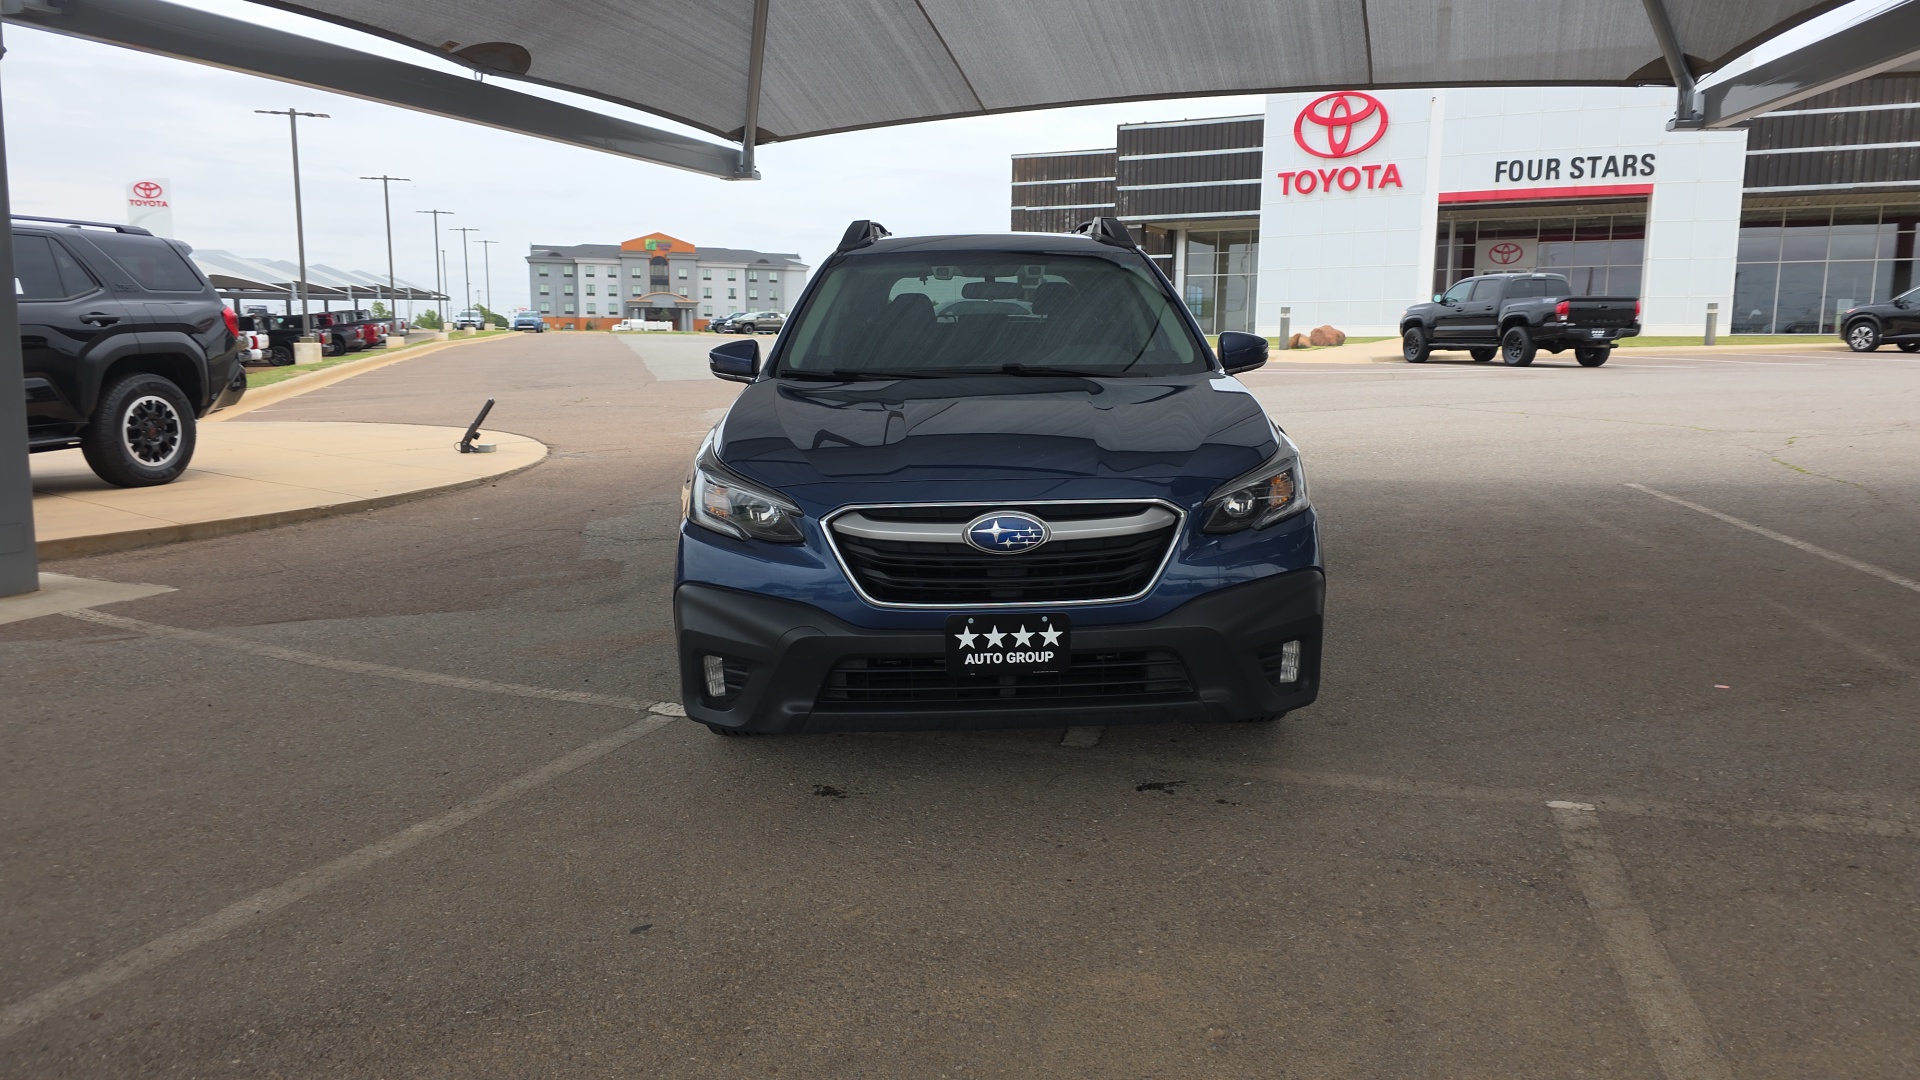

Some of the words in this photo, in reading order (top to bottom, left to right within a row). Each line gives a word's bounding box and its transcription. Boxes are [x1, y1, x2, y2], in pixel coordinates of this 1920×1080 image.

[1495, 158, 1561, 182] FOUR
[1570, 153, 1656, 179] STARS
[1278, 164, 1403, 195] TOYOTA
[128, 199, 169, 207] TOYOTA
[964, 652, 1003, 665] AUTO
[1006, 651, 1055, 663] GROUP
